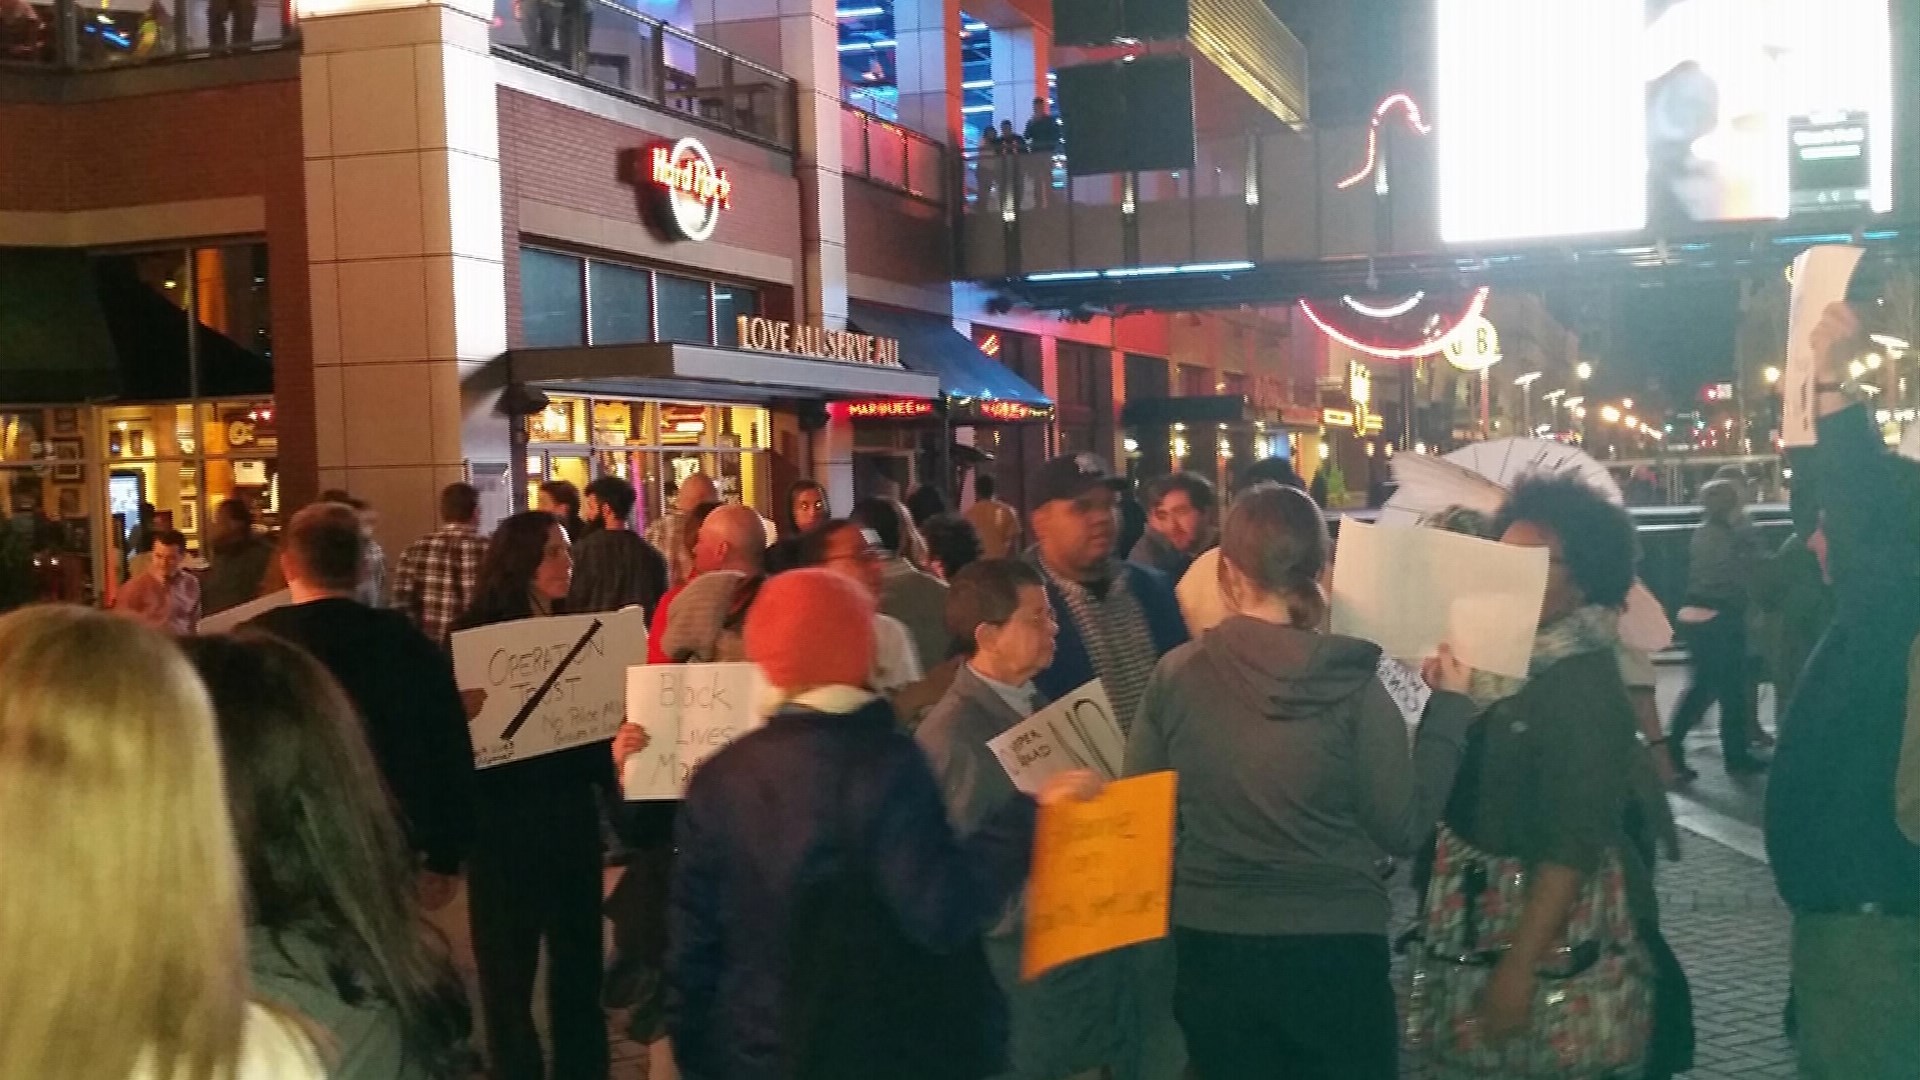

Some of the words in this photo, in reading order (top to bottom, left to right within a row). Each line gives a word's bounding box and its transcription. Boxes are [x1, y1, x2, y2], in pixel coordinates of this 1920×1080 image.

[653, 149, 693, 192] Hard
[737, 315, 790, 352] LOVE
[794, 324, 825, 358] ALL
[825, 329, 875, 365] SERVE
[875, 336, 900, 367] ALL
[849, 400, 914, 417] MARQUEE
[488, 636, 604, 686] OPERATON
[659, 670, 733, 711] Black
